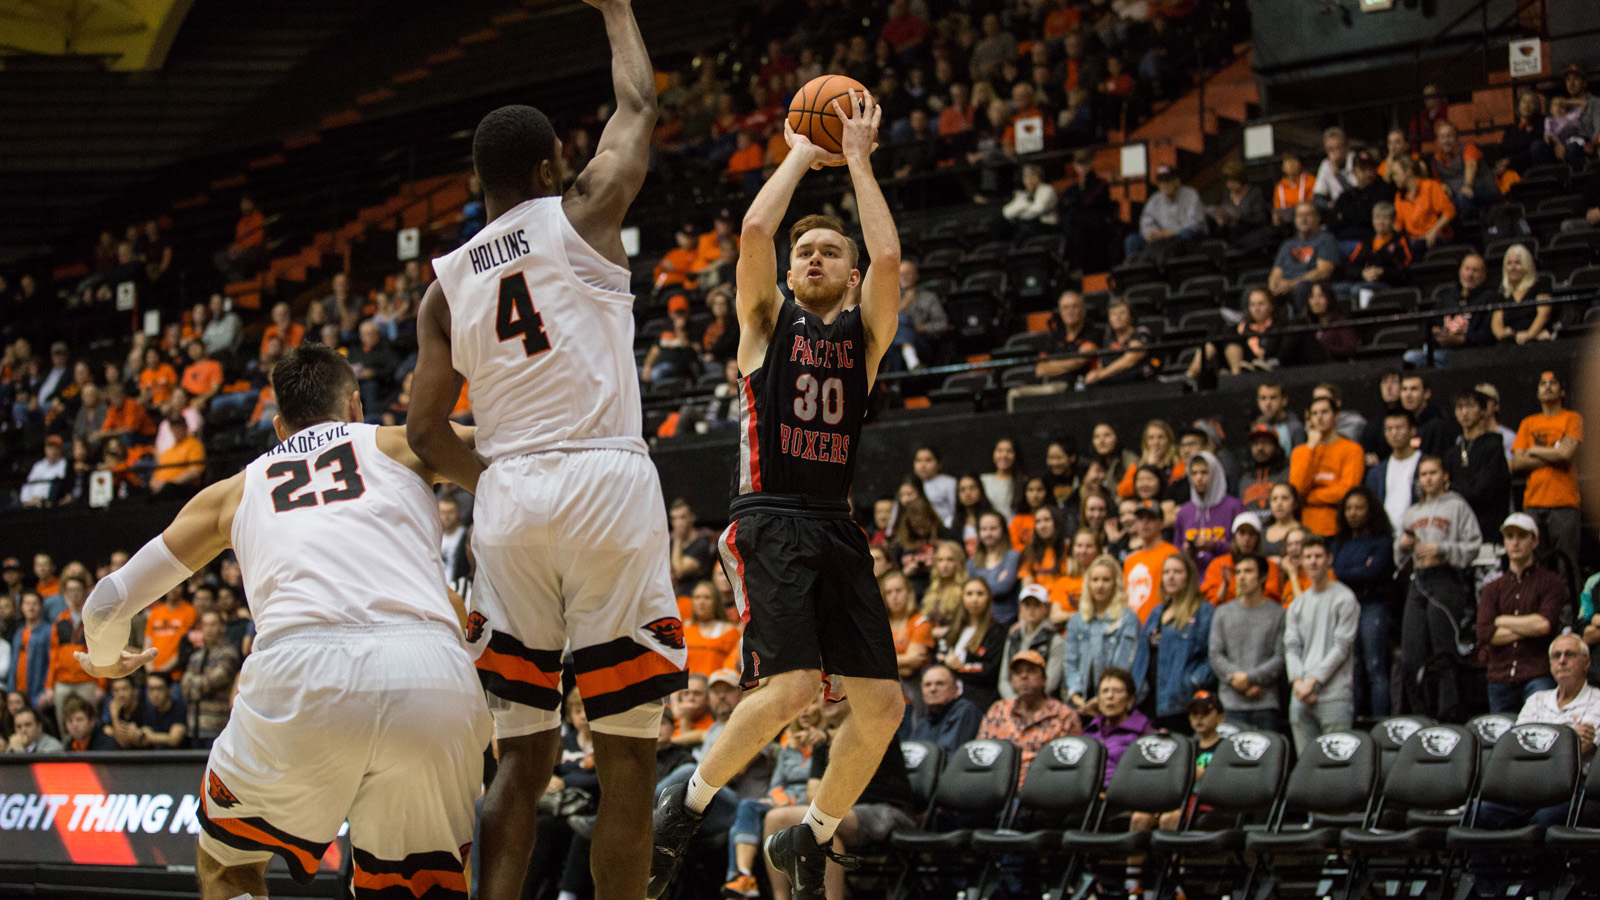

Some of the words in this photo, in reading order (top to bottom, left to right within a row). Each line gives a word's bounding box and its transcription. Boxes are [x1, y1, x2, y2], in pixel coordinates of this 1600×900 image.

[469, 229, 531, 275] HOLLINS
[495, 271, 552, 358] 4
[793, 373, 844, 425] 30
[266, 423, 349, 457] AKOČEVIC
[780, 423, 850, 464] BOXERS
[265, 441, 366, 513] 23
[67, 794, 174, 834] THING
